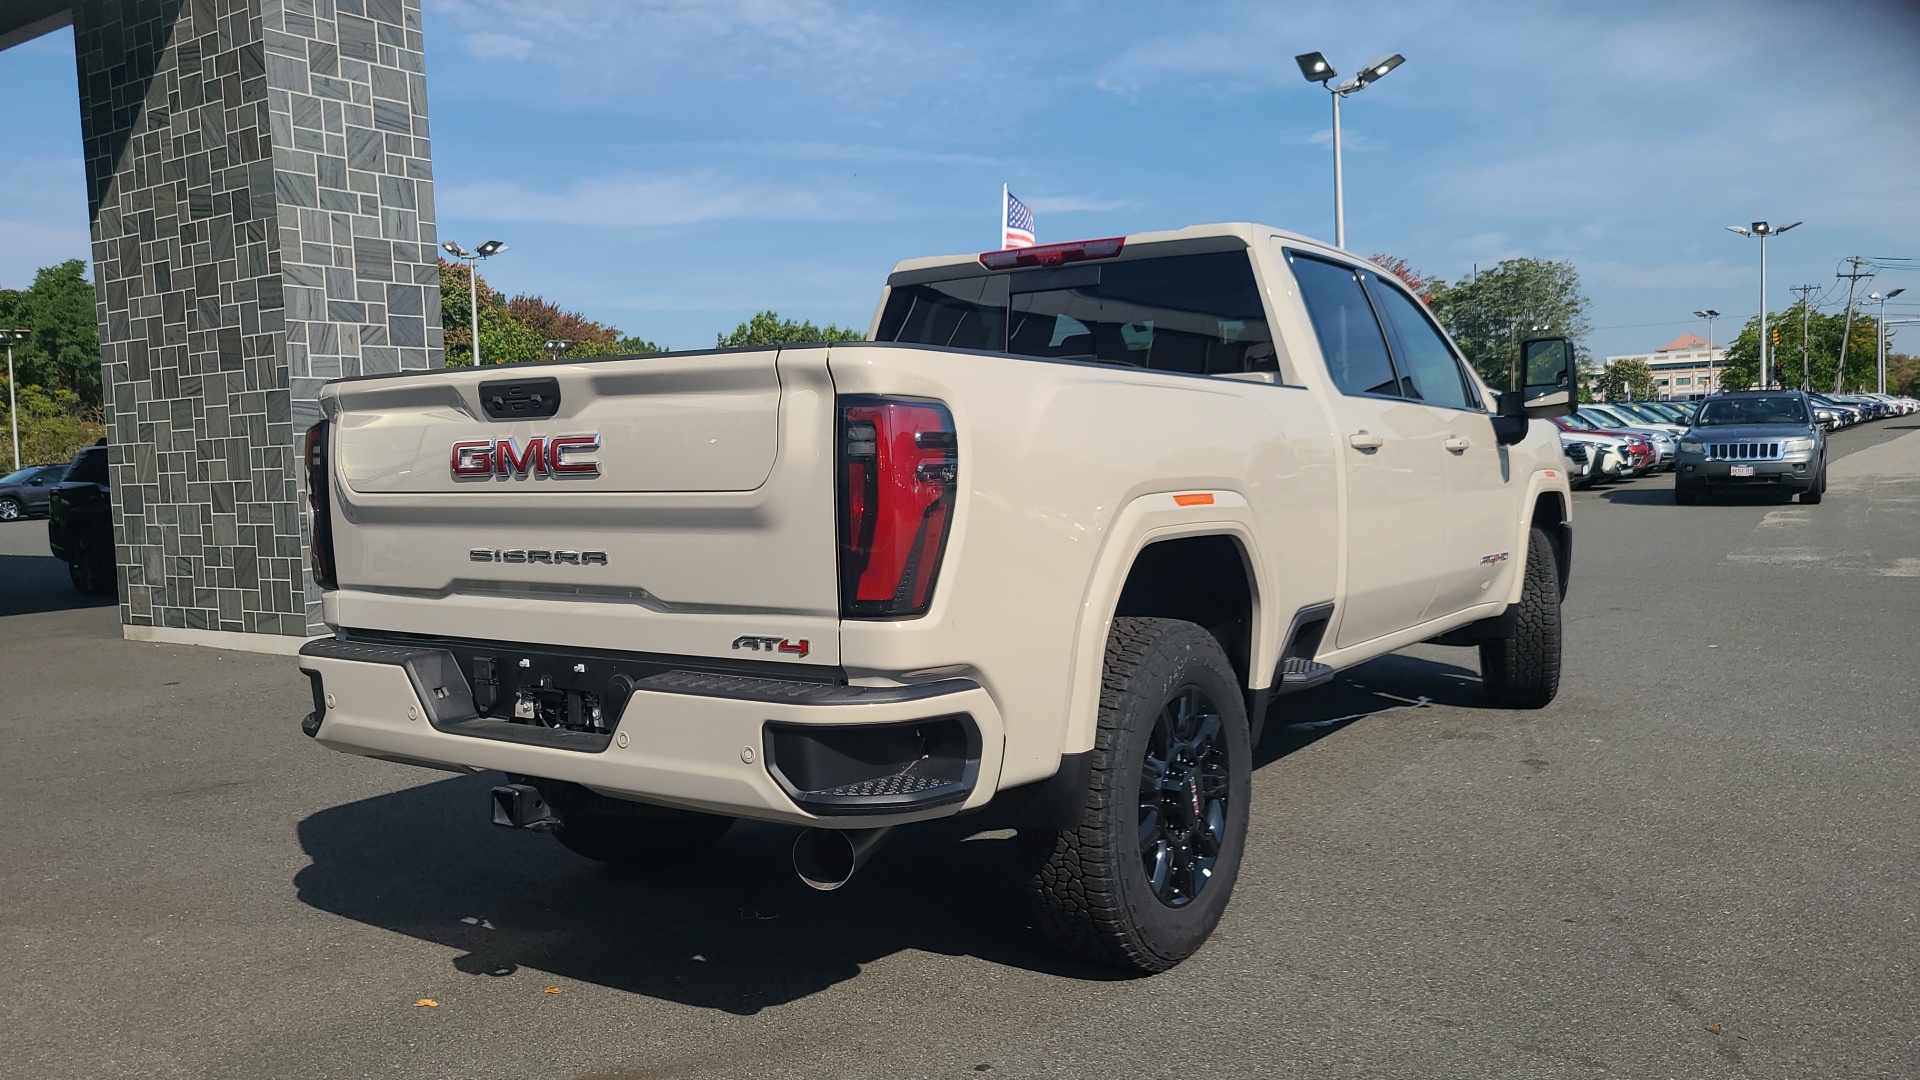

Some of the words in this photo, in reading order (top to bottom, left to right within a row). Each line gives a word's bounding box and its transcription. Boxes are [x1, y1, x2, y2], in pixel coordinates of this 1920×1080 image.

[451, 434, 601, 483] GMC
[470, 548, 608, 566] SIERRA
[732, 635, 809, 659] AT4
